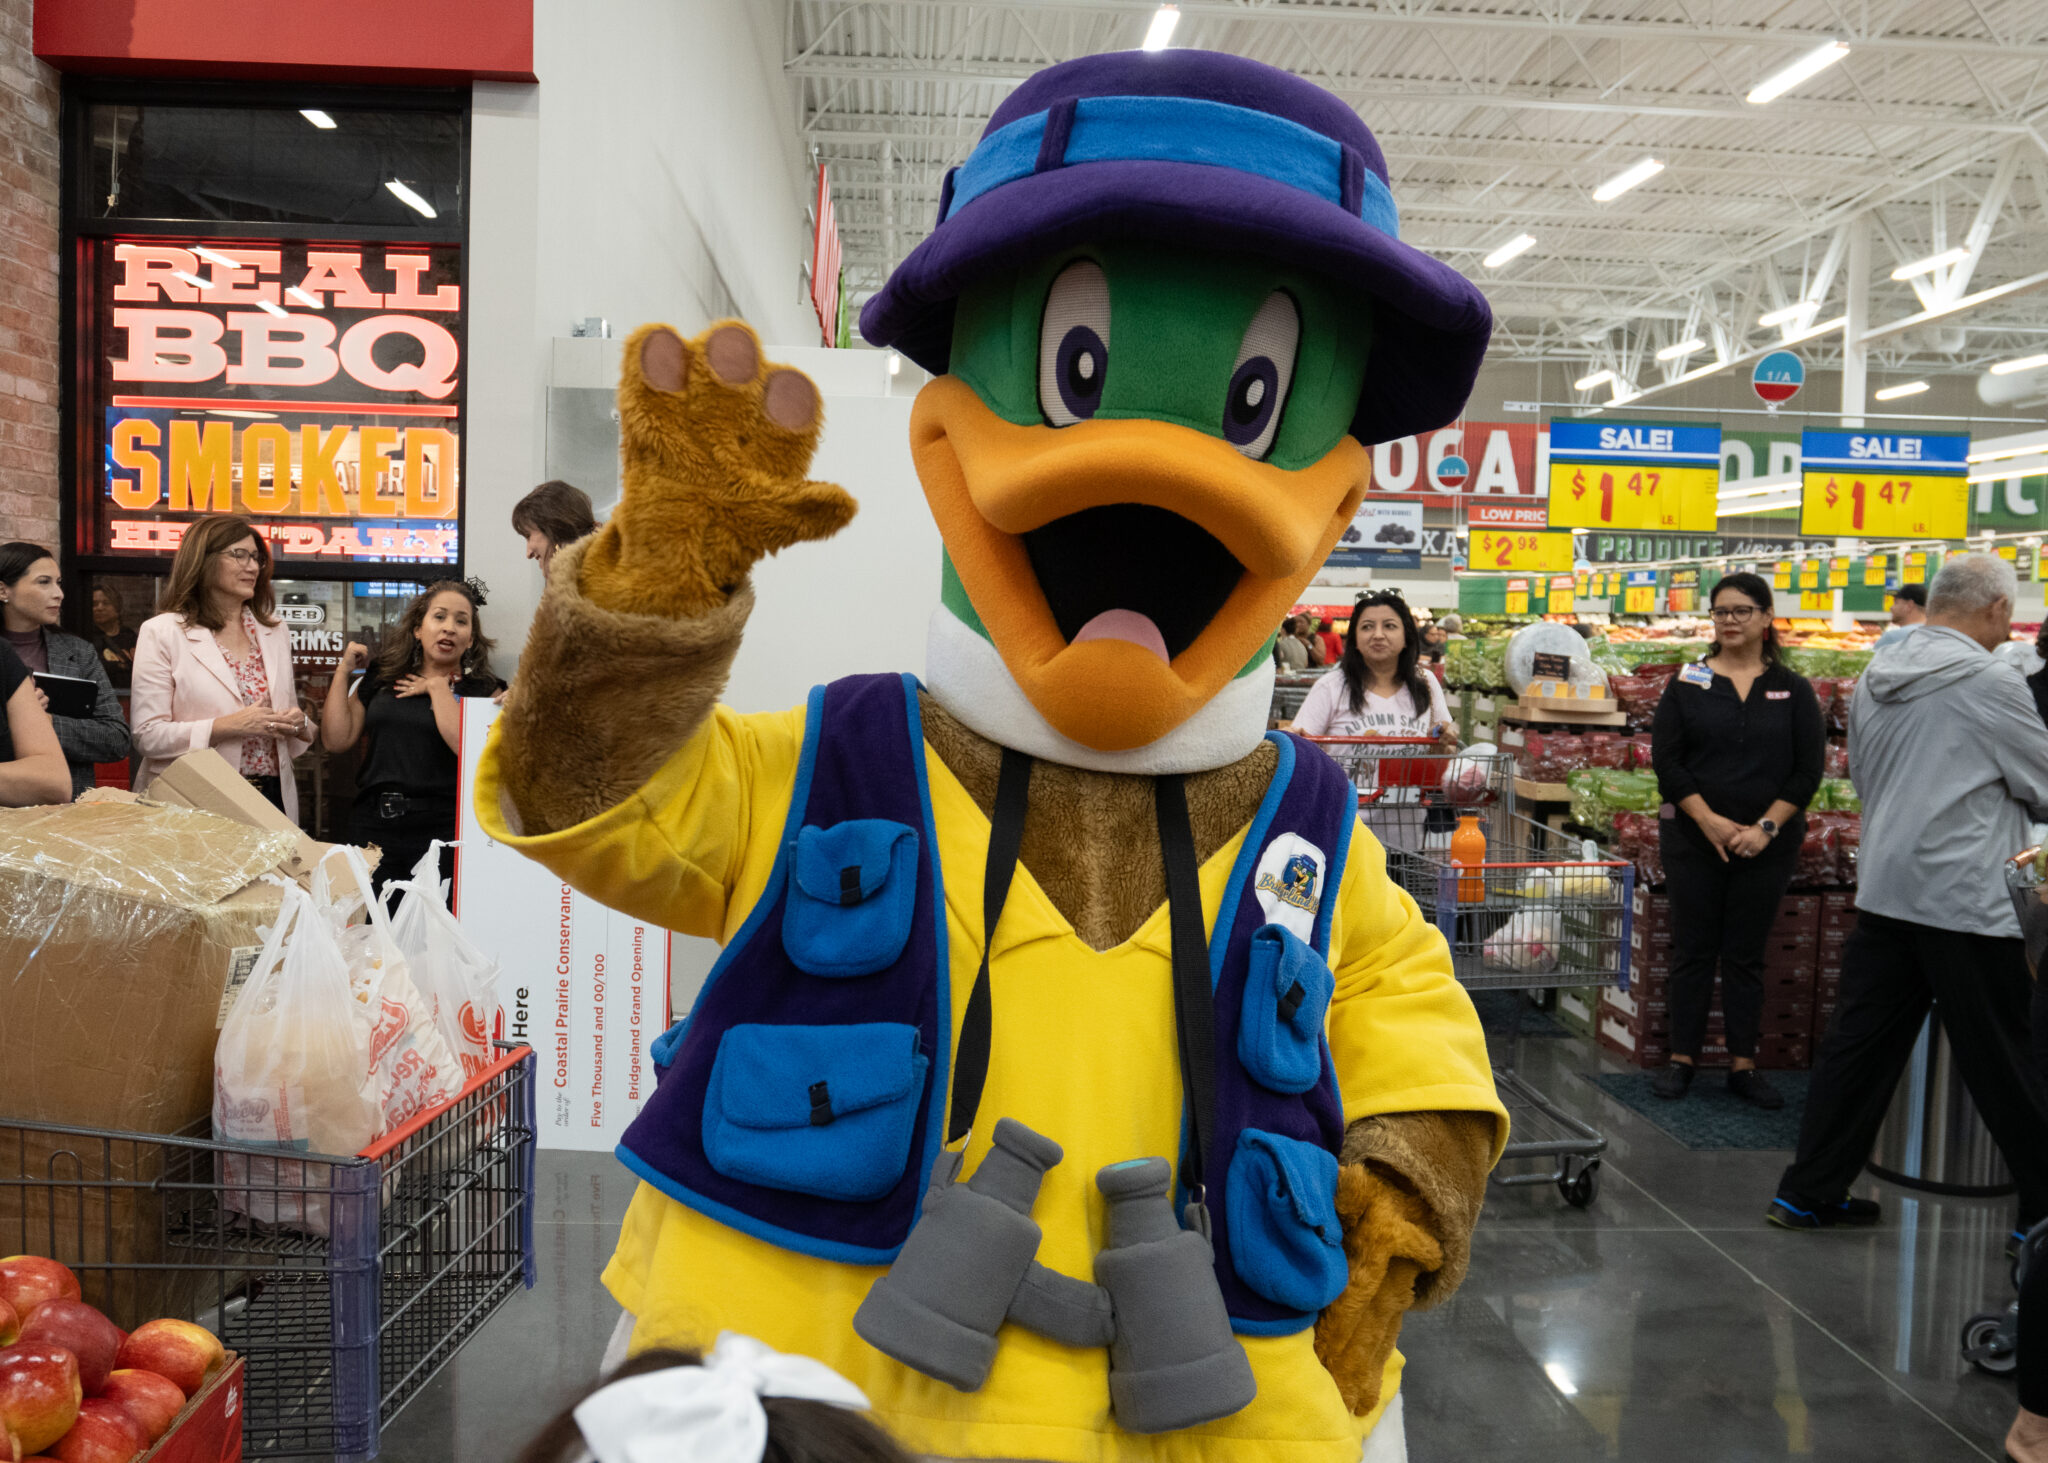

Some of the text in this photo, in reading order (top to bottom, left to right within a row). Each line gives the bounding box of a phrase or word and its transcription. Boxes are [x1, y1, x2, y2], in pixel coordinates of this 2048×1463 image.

[114, 244, 460, 311] REAL
[113, 308, 459, 399] BBQ
[1372, 428, 1550, 494] OCA
[1599, 428, 1674, 451] SALE!
[1849, 437, 1922, 460] SALE!
[112, 418, 458, 518] SMOKED
[1481, 509, 1547, 522] LOW PRIC
[1597, 536, 1723, 562] PRODUCE
[289, 630, 344, 652] RINKS
[1344, 713, 1426, 736] AUTUMN SKIE
[631, 926, 644, 982] Opening
[512, 987, 529, 1038] Here
[555, 979, 570, 1028] Prairie
[630, 985, 641, 1025] Grand
[554, 1032, 568, 1088] Coastal
[591, 953, 606, 1127] Five Thousand and 00/100
[629, 1029, 641, 1100] Bridgeland
